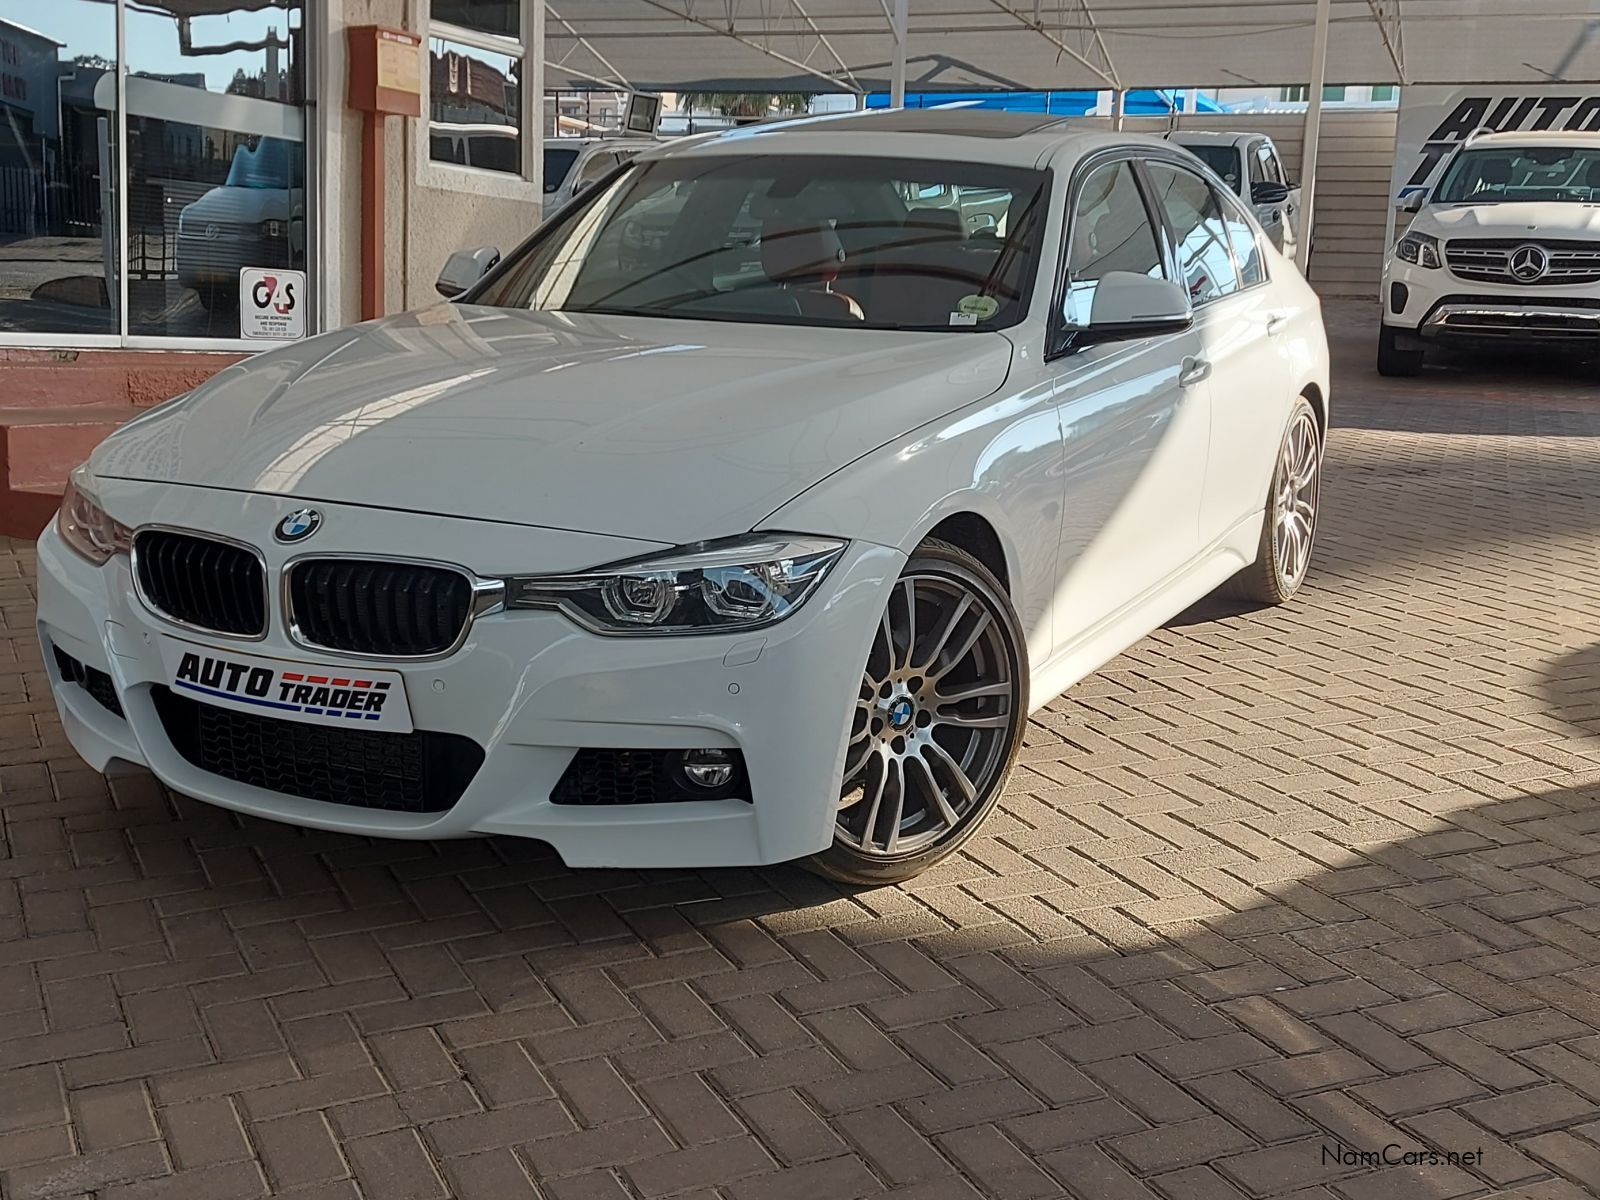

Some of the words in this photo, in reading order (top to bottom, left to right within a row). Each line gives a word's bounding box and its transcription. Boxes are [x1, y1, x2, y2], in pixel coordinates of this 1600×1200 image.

[1428, 97, 1600, 141] AUTO
[252, 276, 296, 315] G4S
[176, 652, 275, 697] AUTO
[279, 681, 388, 712] TRADER
